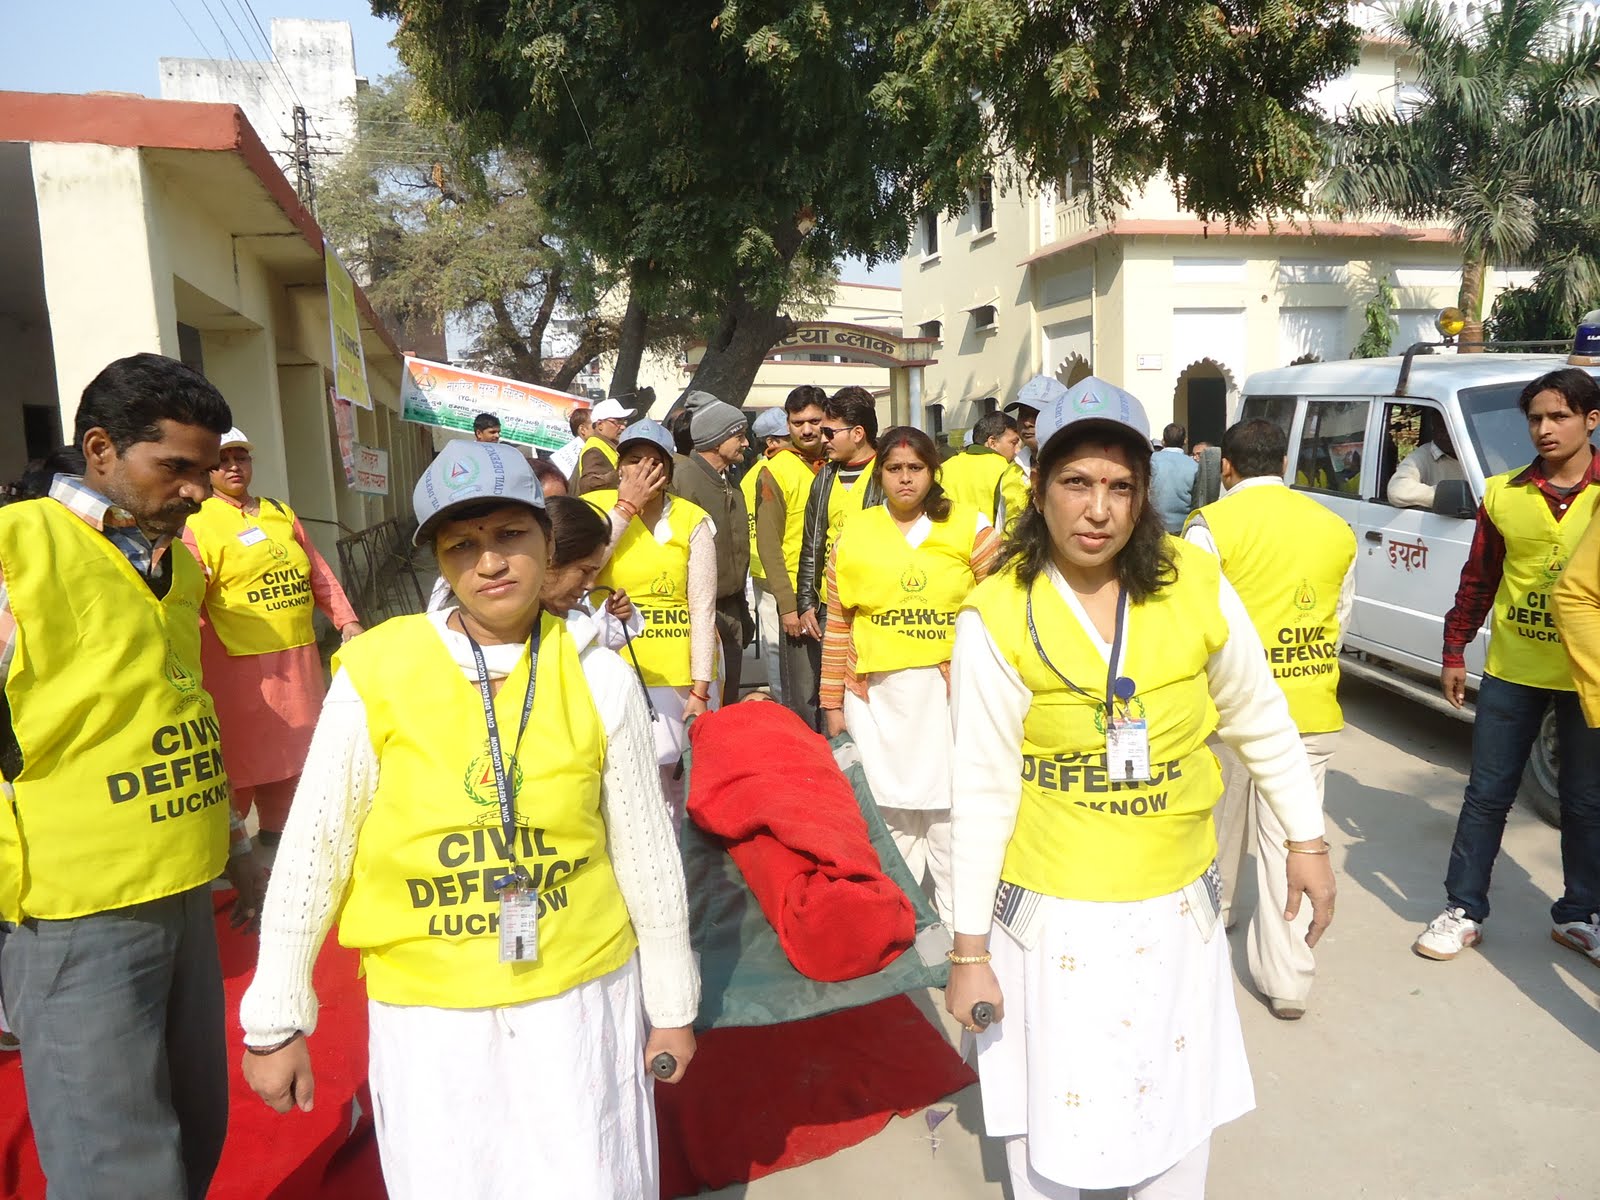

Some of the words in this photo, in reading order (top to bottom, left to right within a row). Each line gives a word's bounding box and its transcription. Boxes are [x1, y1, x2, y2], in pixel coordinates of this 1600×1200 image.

[834, 332, 896, 355] ब्लाक
[493, 475, 505, 496] CIVIL
[262, 568, 305, 586] CIVIL
[643, 609, 691, 625] FENC
[1507, 605, 1556, 628] DEFE
[637, 627, 691, 639] UCKNOW
[1278, 626, 1326, 645] CIVIL
[1518, 627, 1561, 643] LUCK
[1264, 642, 1337, 664] EFENC
[474, 650, 487, 681] LUCKNOW
[1273, 663, 1334, 679] LUCKNOW
[480, 681, 492, 711] DEFENCE
[485, 710, 495, 728] CIVIL
[521, 710, 530, 727] CIVIL
[490, 736, 502, 771] LUCKNOW
[106, 748, 225, 805] DEFEN
[1021, 754, 1183, 793] DEFECE
[495, 771, 507, 803] DEFENCE
[150, 781, 227, 823] LUCKN
[501, 803, 511, 823] CIVIL
[437, 826, 558, 869] CIVIL
[428, 886, 568, 936] LUCKOW
